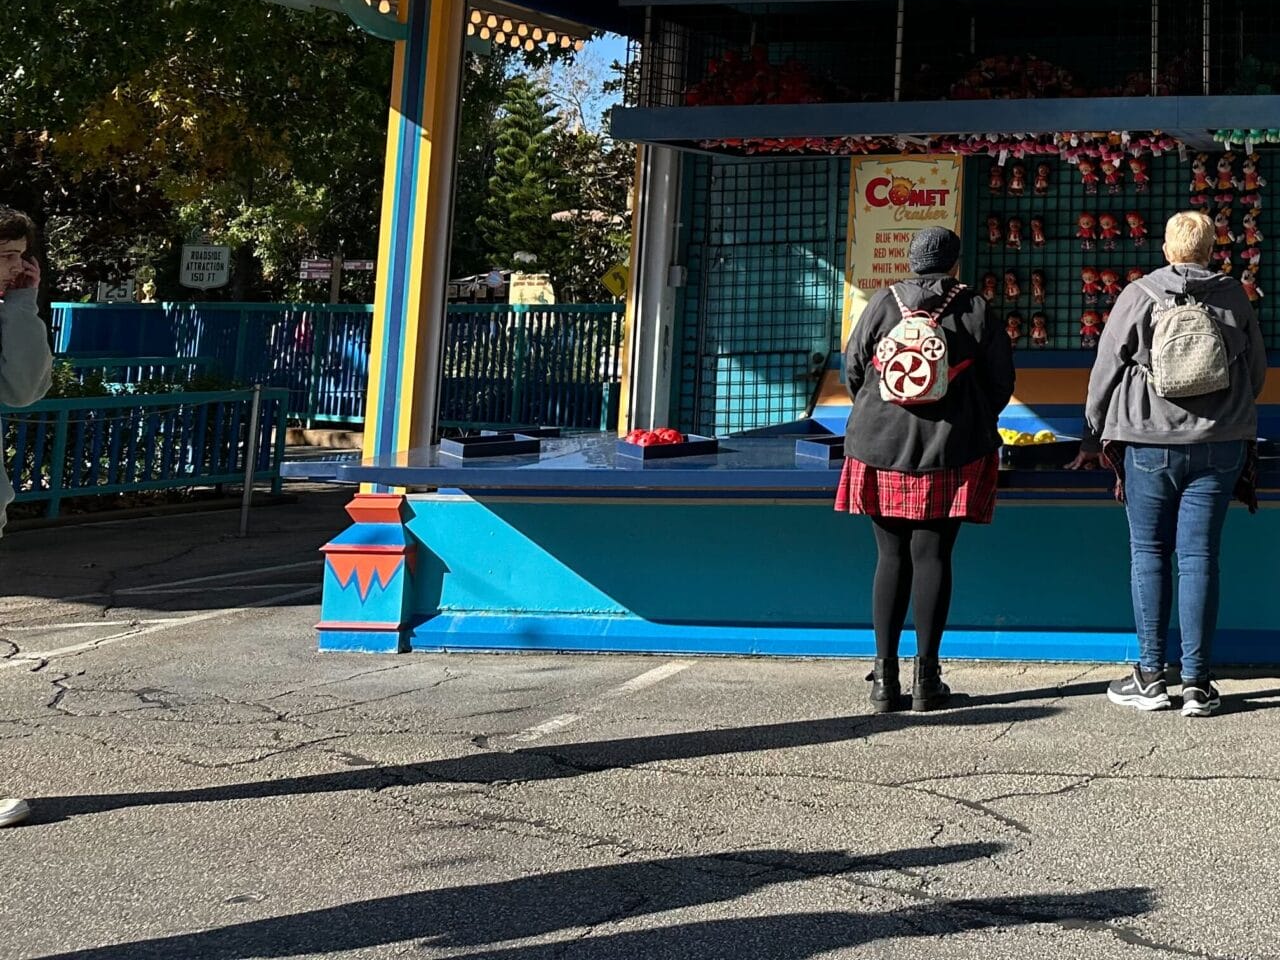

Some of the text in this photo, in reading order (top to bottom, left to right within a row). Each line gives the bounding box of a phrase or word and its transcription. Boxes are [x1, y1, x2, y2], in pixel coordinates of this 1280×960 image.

[865, 177, 950, 208] COMET
[893, 205, 949, 222] Crasher
[875, 232, 892, 243] BLUE
[893, 232, 910, 243] WINS
[190, 250, 222, 260] ROADSIDE
[874, 248, 887, 258] RED
[888, 247, 905, 258] WINS
[186, 261, 225, 271] ATTRACTION
[872, 262, 911, 274] WHITE WINS
[207, 272, 216, 281] FT
[858, 278, 882, 289] YELLOW
